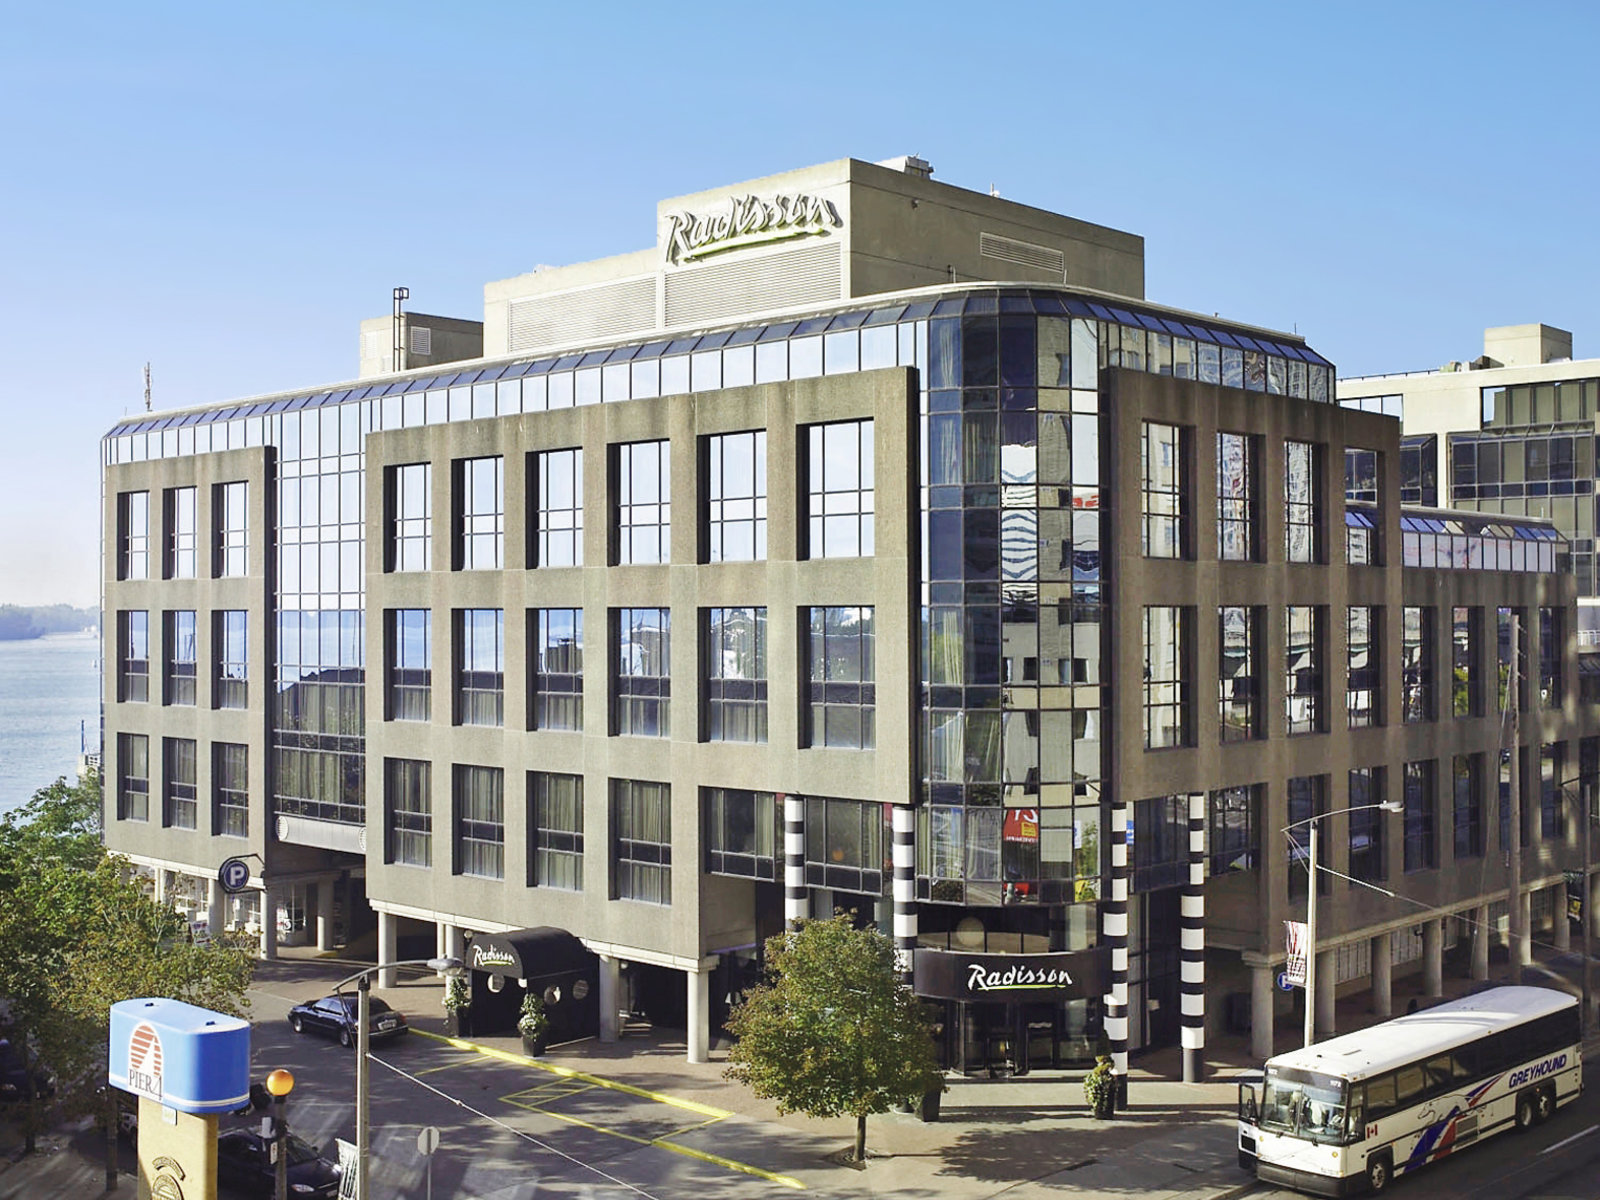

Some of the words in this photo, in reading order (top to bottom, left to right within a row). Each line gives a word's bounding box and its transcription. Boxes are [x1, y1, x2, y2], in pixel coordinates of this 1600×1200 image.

[666, 193, 842, 263] Radisson
[230, 866, 245, 886] P
[473, 944, 516, 967] Radisson
[967, 964, 1073, 991] Radisson
[129, 1069, 152, 1092] PIER
[152, 1075, 163, 1101] 4
[1509, 1054, 1567, 1088] GREYHOUND
